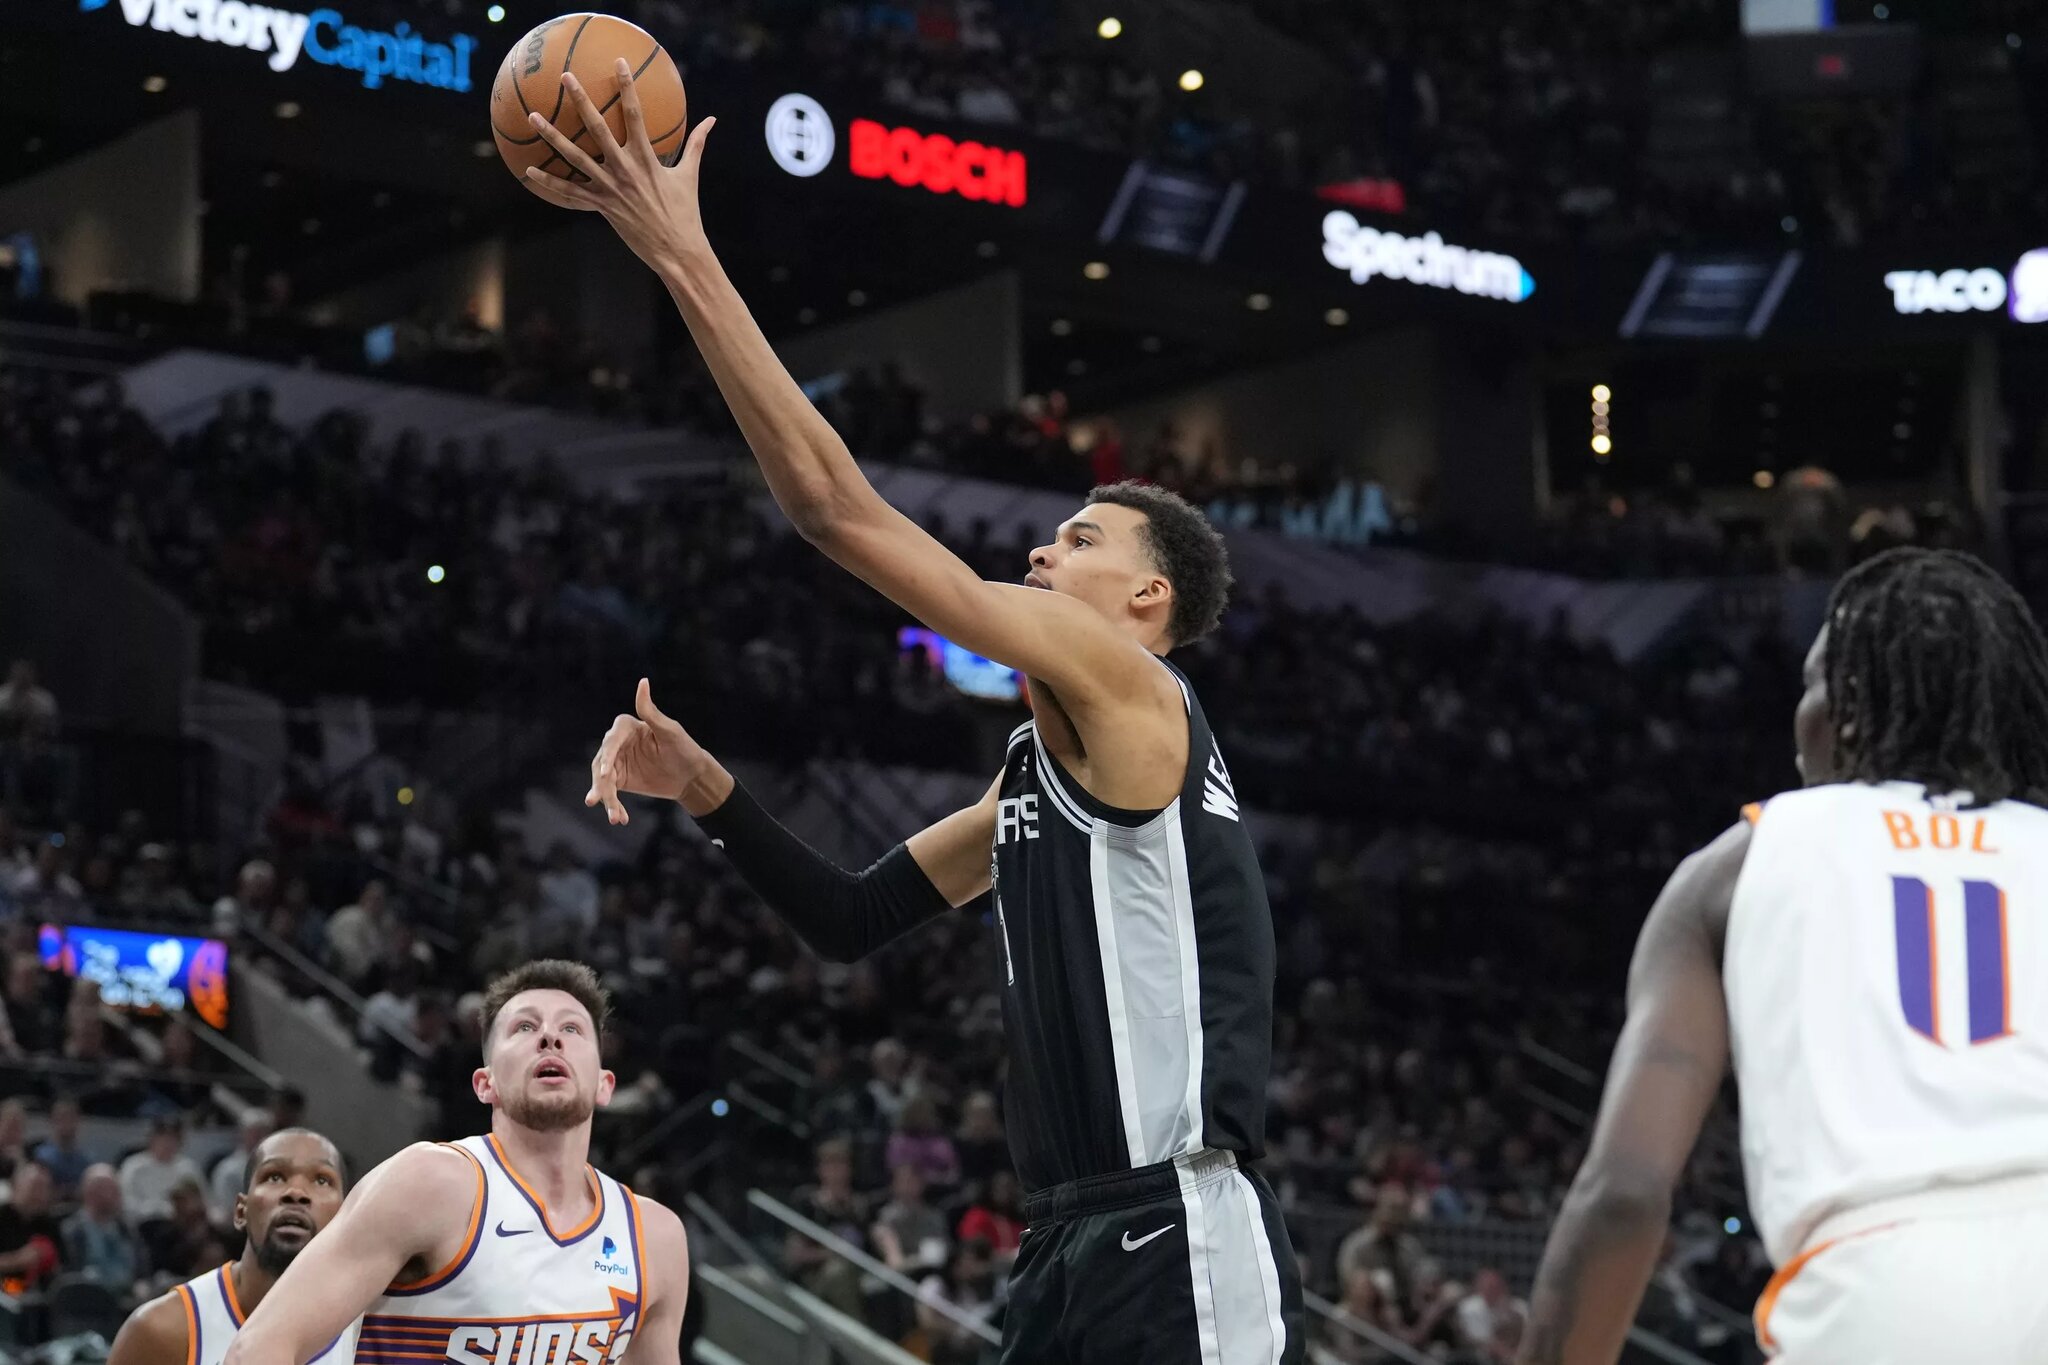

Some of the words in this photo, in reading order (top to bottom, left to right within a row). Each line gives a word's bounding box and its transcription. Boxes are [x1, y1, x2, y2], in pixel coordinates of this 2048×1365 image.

[850, 117, 1026, 208] BOSCH
[1322, 210, 1523, 303] Spectrum
[1884, 267, 2007, 314] TACO
[1882, 811, 1999, 853] BOL
[1889, 876, 2015, 1049] 11
[594, 1260, 628, 1275] PayPal
